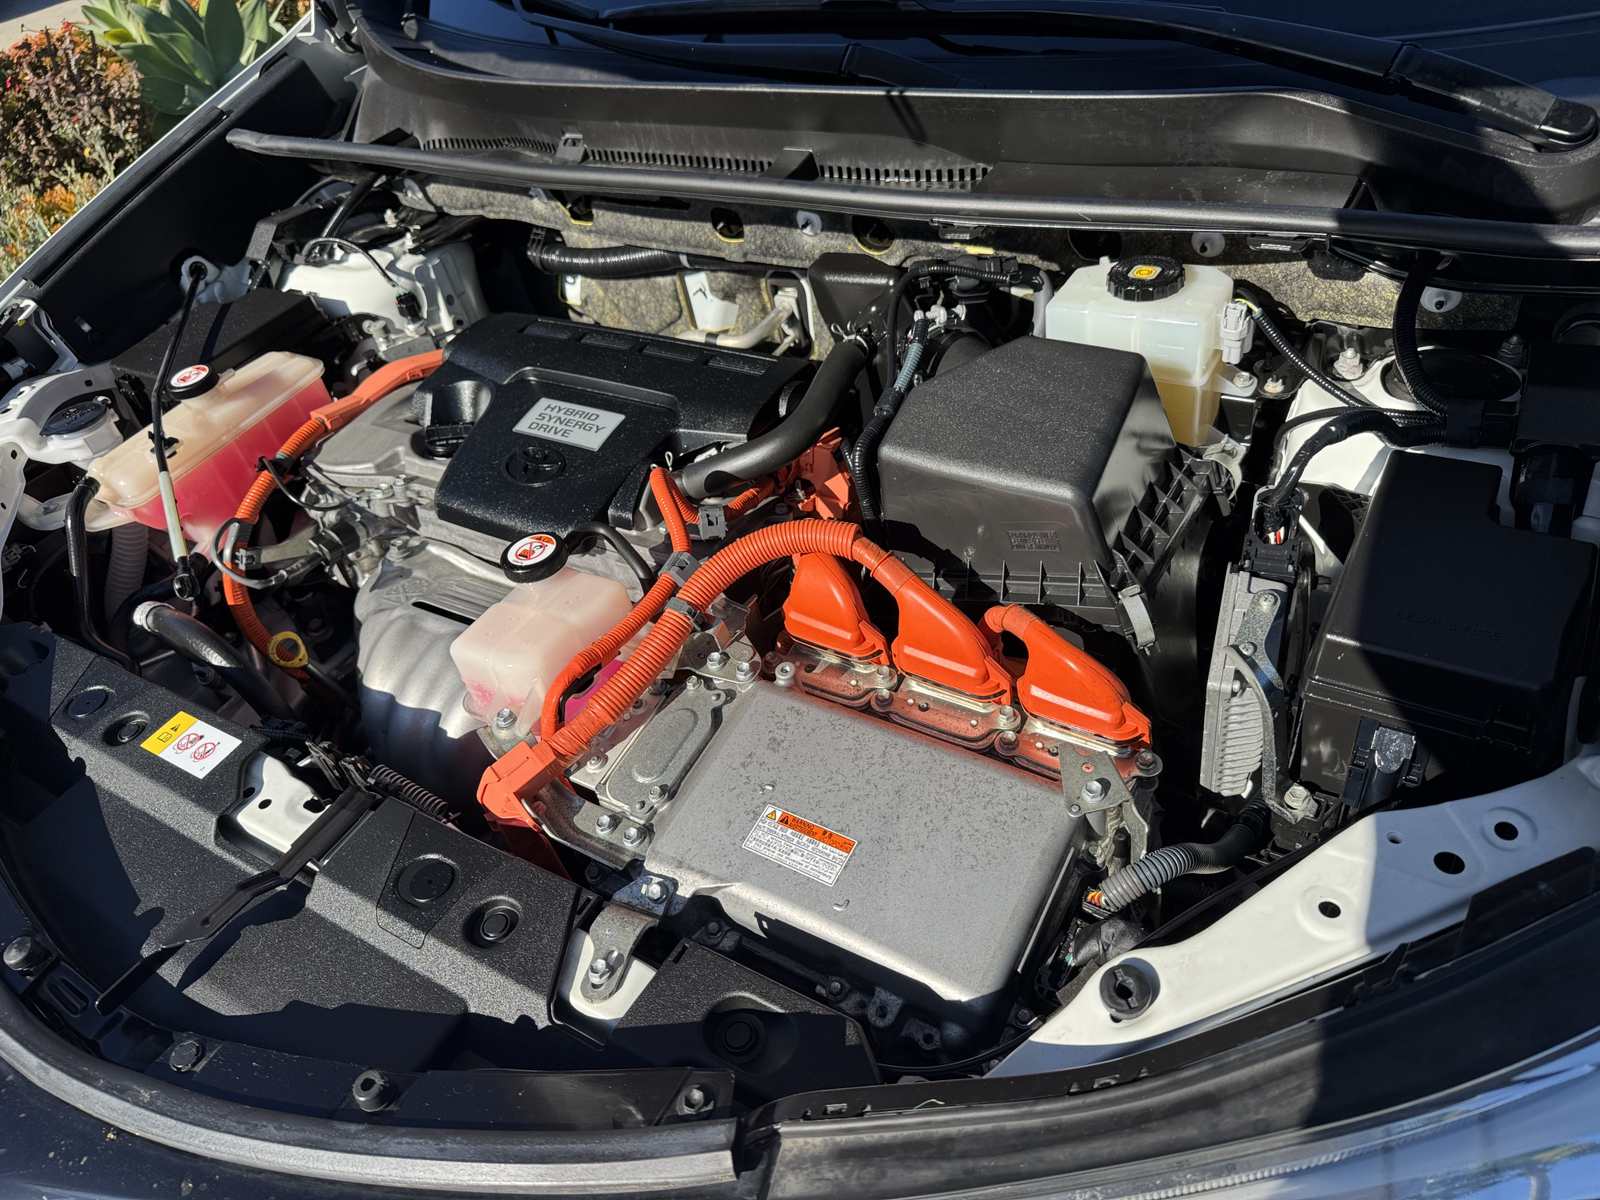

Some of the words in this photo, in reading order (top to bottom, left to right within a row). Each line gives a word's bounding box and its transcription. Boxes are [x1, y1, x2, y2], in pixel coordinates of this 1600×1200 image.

[544, 403, 600, 421] HYBRID
[527, 421, 573, 438] DRIVE
[535, 412, 606, 434] SYNERGY
[1394, 609, 1443, 627] RELAY
[1446, 621, 1457, 631] &
[1461, 625, 1502, 641] FUSE
